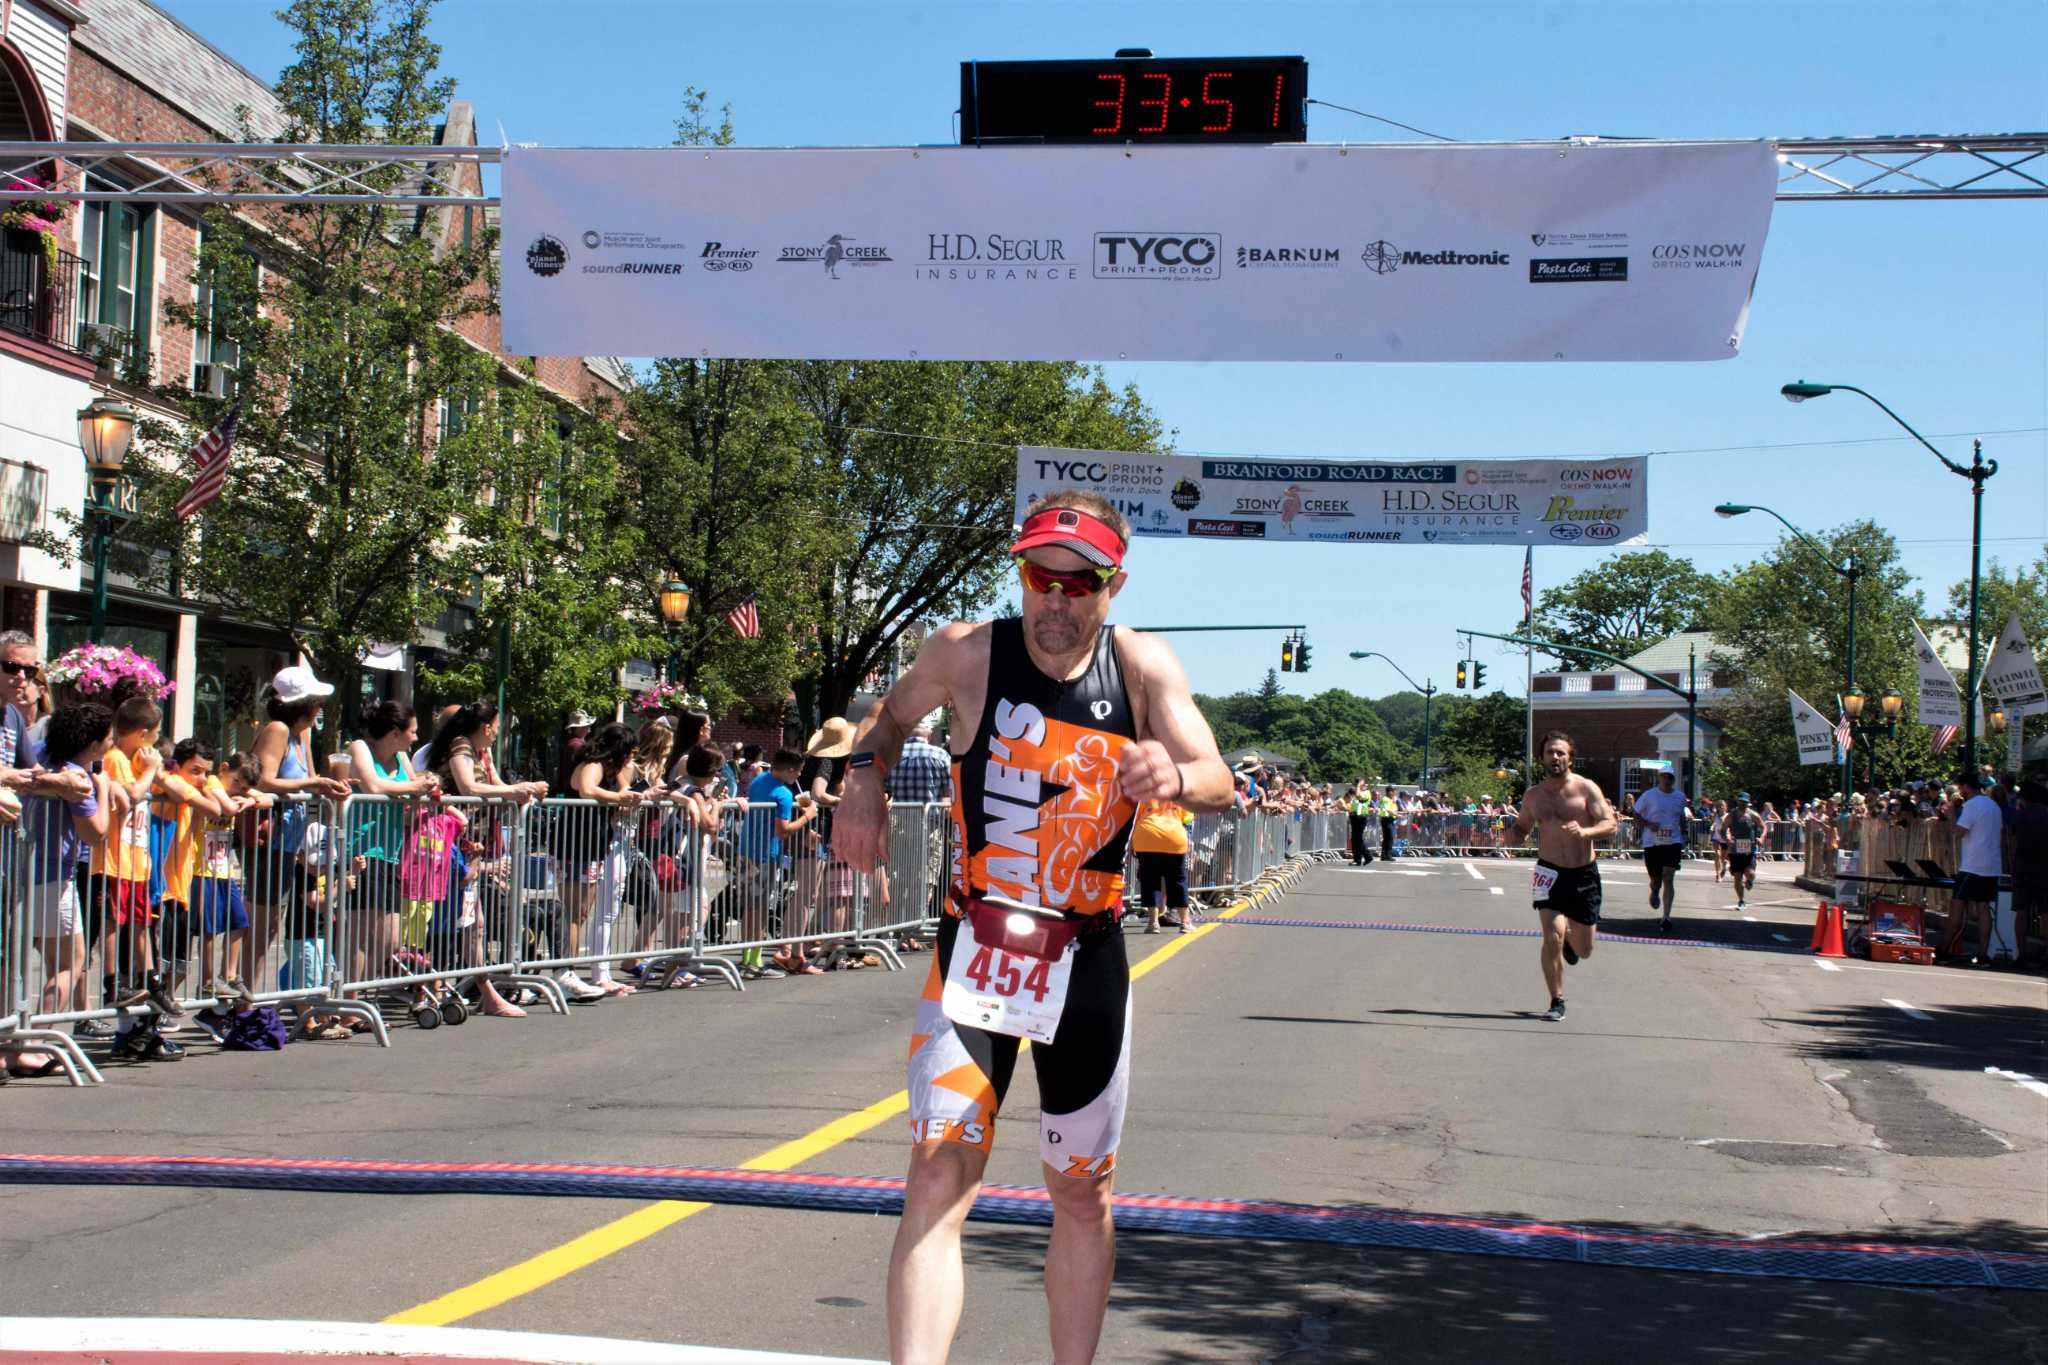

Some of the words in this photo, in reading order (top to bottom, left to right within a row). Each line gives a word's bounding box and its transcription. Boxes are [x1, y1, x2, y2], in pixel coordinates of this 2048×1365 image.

[698, 241, 760, 259] Premier
[781, 247, 823, 257] STONY
[845, 247, 887, 257] CREEK
[928, 233, 981, 261] H.D.
[987, 233, 1065, 261] SEGUR
[1099, 237, 1216, 266] TYCO
[530, 255, 557, 263] planet
[1249, 248, 1340, 261] BARNUM
[1402, 250, 1510, 265] Medtronic
[582, 263, 682, 275] soundRUNNER
[731, 262, 749, 270] KIA
[1537, 262, 1567, 274] Pasta
[1568, 261, 1592, 273] Cosi
[1652, 260, 1690, 269] ORTHO
[1695, 259, 1742, 268] WALK-IN
[915, 268, 1078, 280] INSURANCE
[1034, 459, 1108, 483] TYCO
[1213, 463, 1321, 479] BRANFORD
[1328, 465, 1385, 480] ROAD
[1391, 467, 1444, 481] RACE
[1112, 474, 1163, 486] PROMO
[1594, 482, 1631, 490] WALK-IN
[1236, 498, 1280, 511] STONY
[1304, 499, 1349, 512] CREEK
[1383, 489, 1434, 511] H.D.
[1441, 489, 1520, 511] SEGUR
[1540, 495, 1629, 522] Premier
[1384, 515, 1520, 526] INSURANCE
[1308, 530, 1402, 540] soundRUNNER
[1590, 526, 1614, 537] KIA
[966, 946, 1051, 1004] 454
